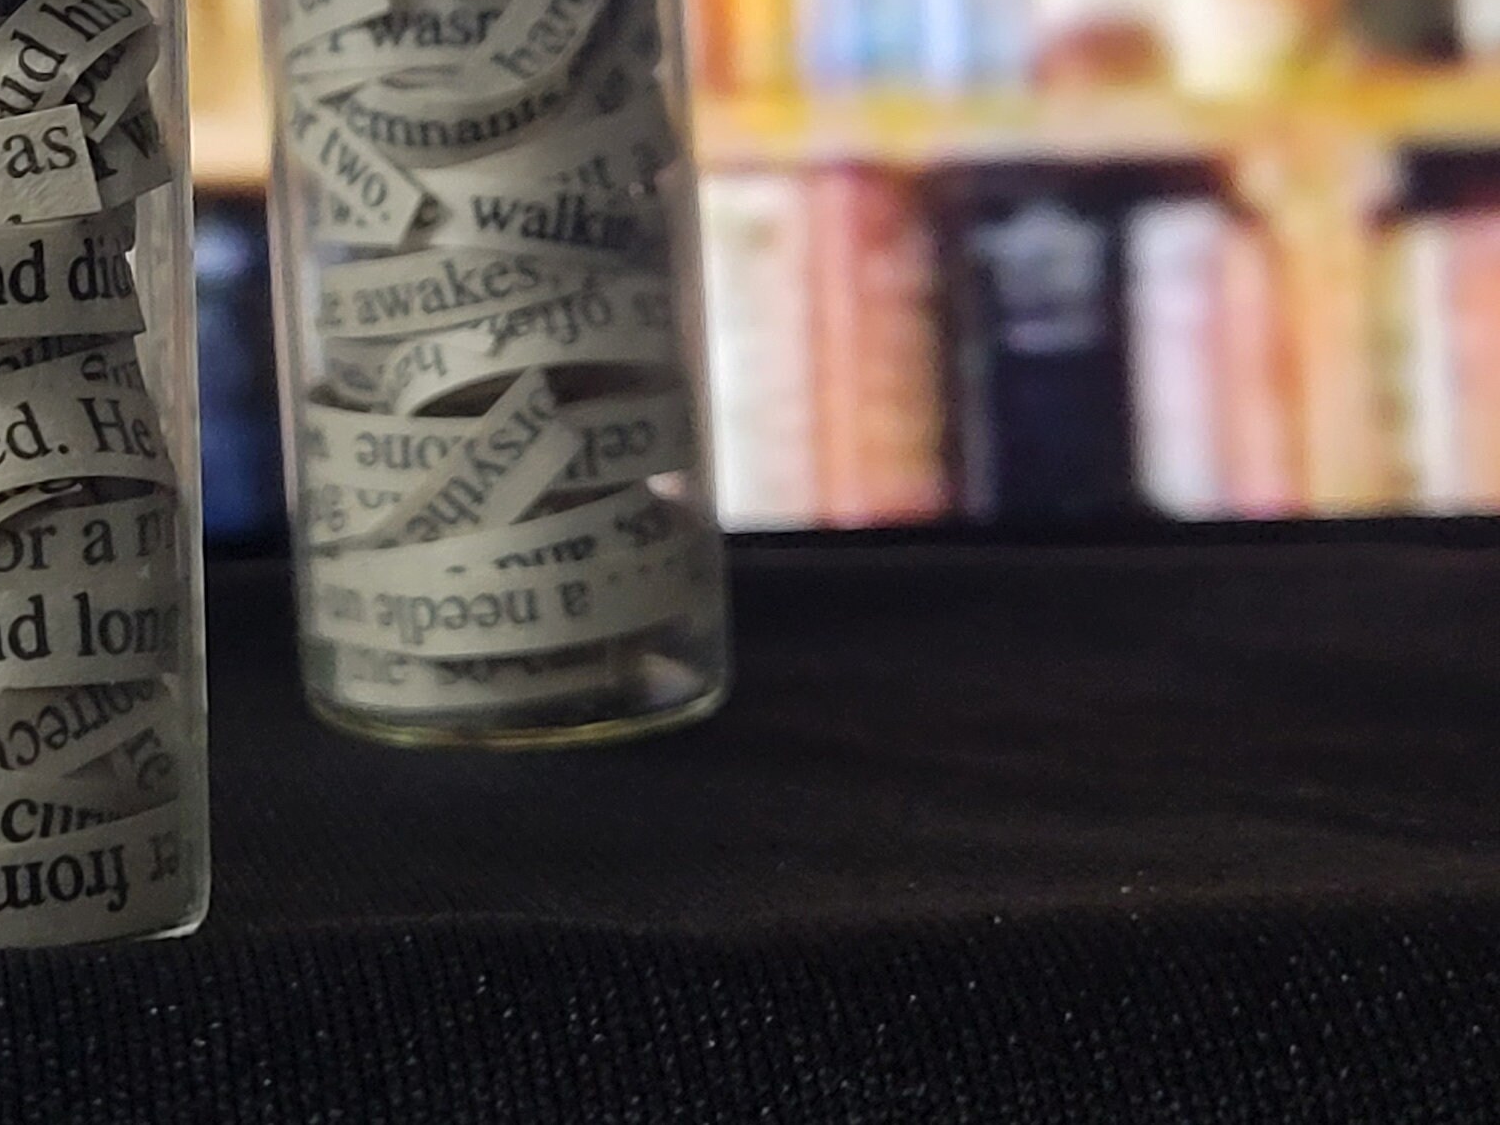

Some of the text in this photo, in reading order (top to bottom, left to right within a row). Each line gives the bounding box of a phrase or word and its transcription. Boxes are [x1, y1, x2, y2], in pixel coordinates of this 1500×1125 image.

[1, 123, 79, 179] as
[76, 395, 157, 460] He
[81, 515, 120, 570] a
